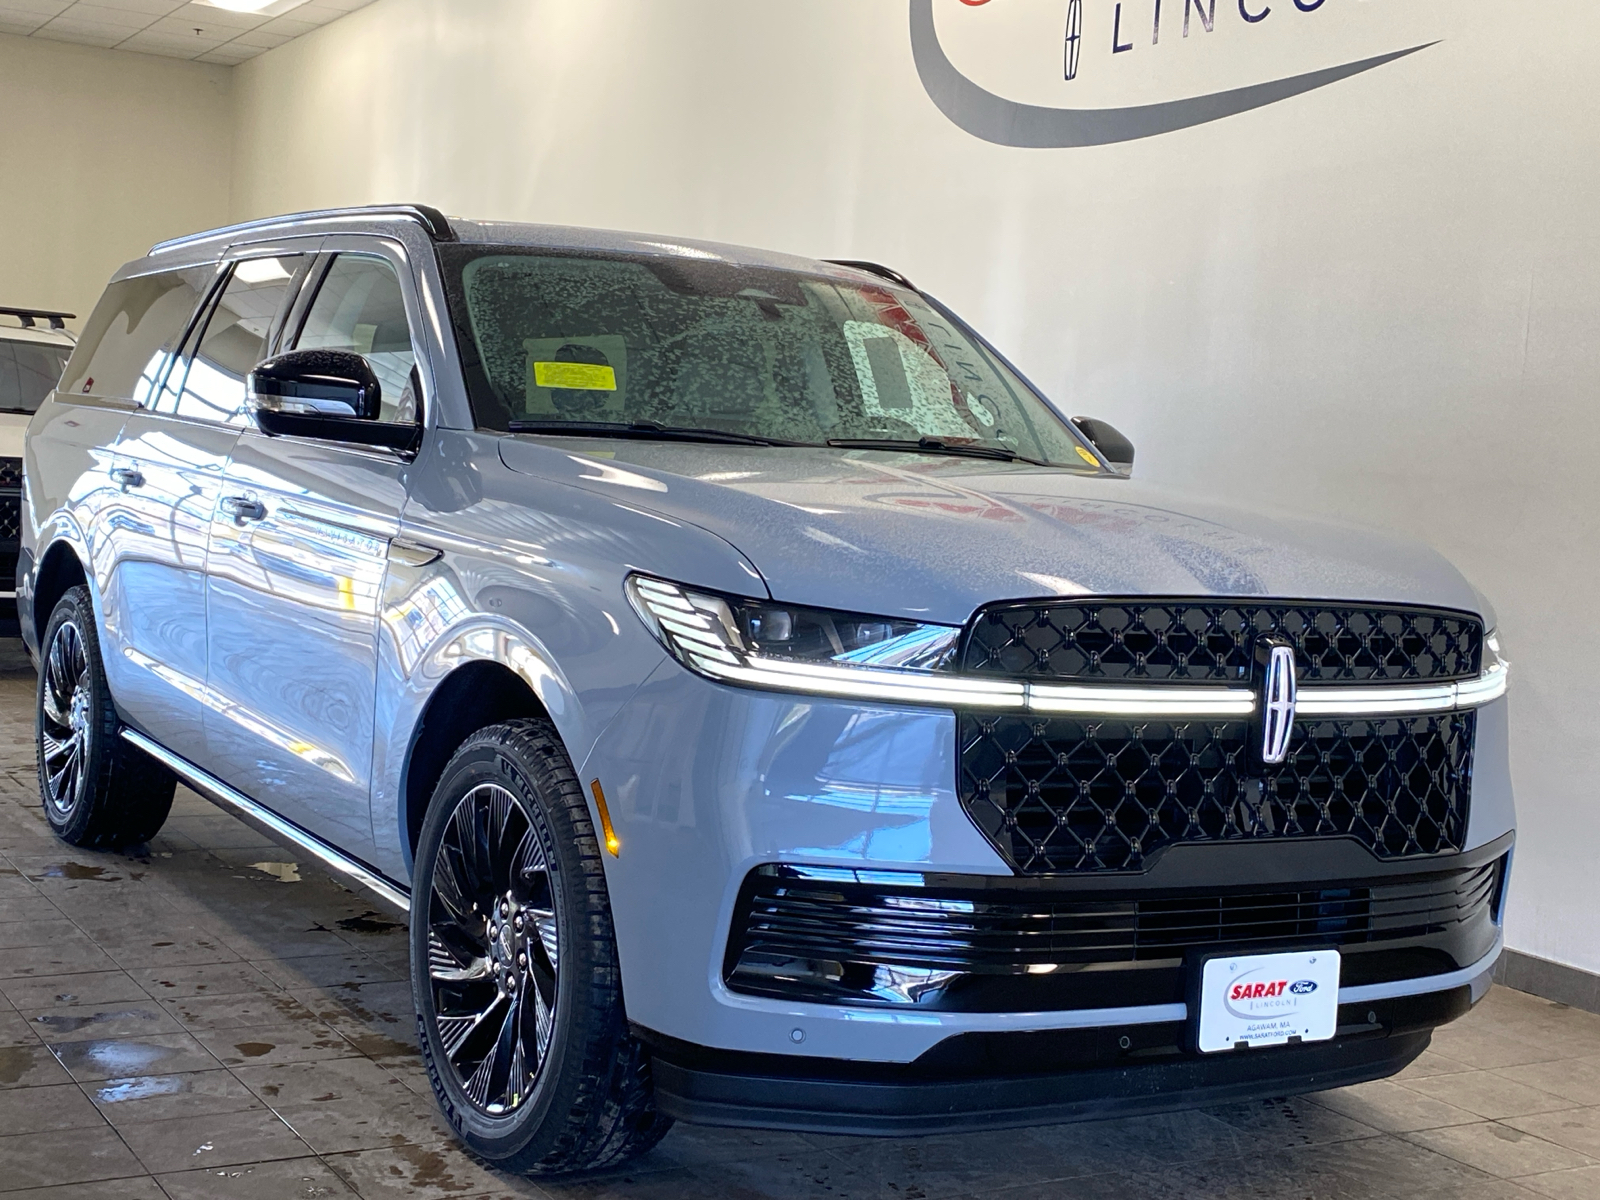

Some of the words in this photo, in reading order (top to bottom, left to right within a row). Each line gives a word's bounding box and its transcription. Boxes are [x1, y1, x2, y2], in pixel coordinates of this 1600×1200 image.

[513, 774, 557, 865] MICHELIN
[1231, 981, 1288, 1000] SARAT
[1293, 981, 1314, 993] Ford
[1255, 1000, 1292, 1008] LINCOLN
[1247, 1022, 1278, 1031] AGAWAM,
[1280, 1021, 1290, 1029] MA
[417, 1019, 453, 1114] MICHELIN
